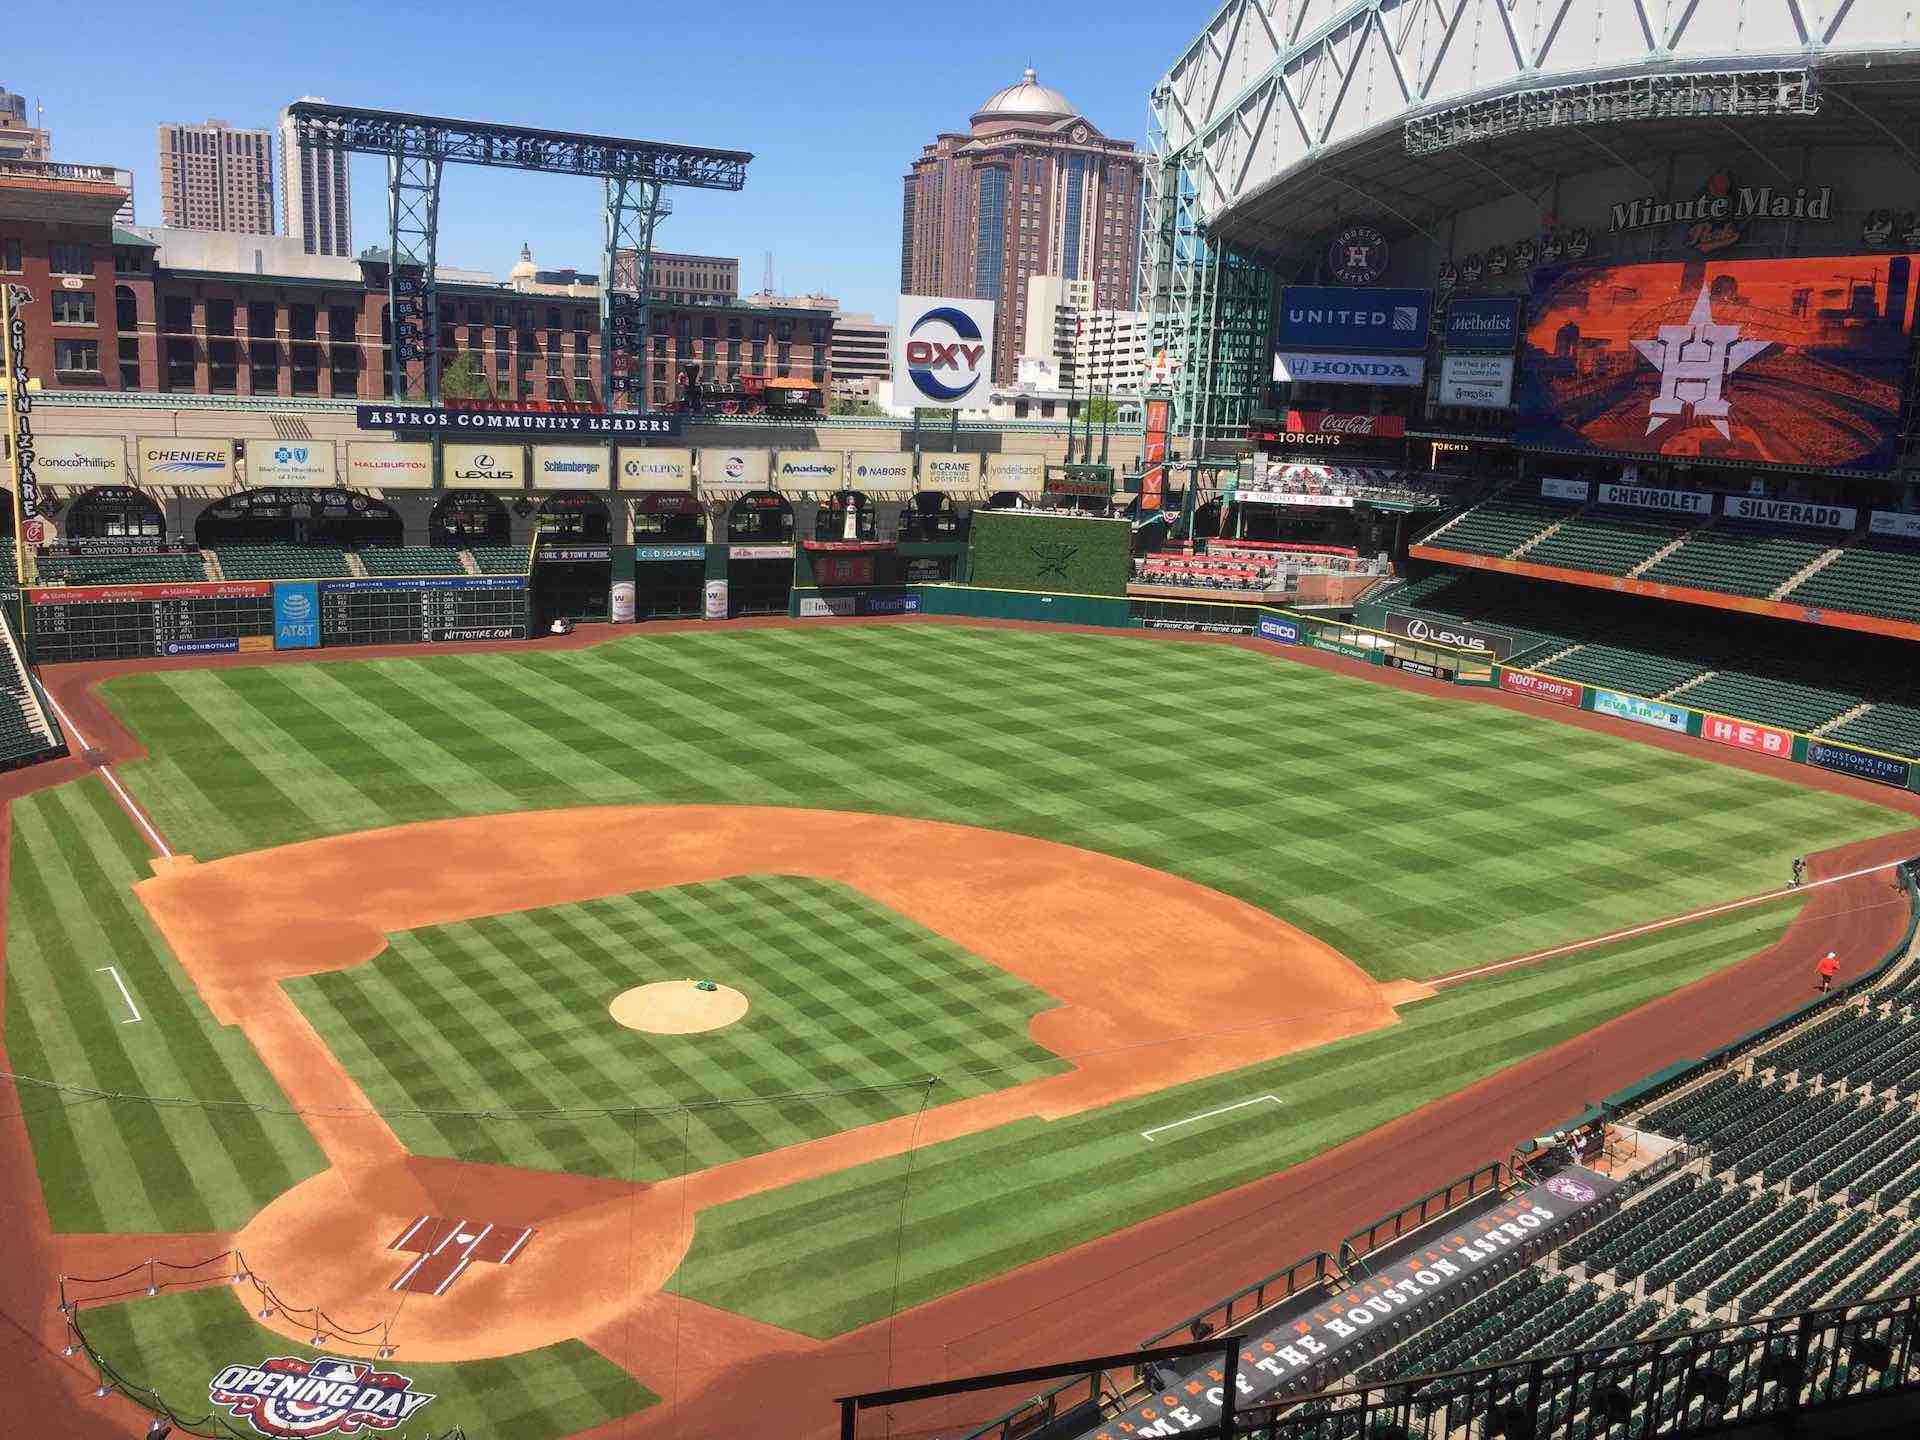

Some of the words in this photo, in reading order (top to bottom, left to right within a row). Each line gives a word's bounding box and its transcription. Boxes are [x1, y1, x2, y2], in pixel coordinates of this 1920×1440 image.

[1608, 194, 1729, 232] Minute
[1736, 185, 1832, 220] Maid
[1337, 229, 1383, 246] HOUSTON
[1289, 309, 1387, 326] UNITED
[1451, 314, 1511, 330] Methodist
[906, 341, 985, 371] OXY
[1311, 361, 1410, 377] HONDA
[370, 411, 448, 426] ASTROS
[457, 414, 580, 430] COMMUNITY
[589, 418, 671, 432] LEADERS
[1278, 431, 1341, 446] TORCHYS
[38, 456, 116, 470] ConocoPhillips
[148, 450, 225, 462] CHENIERE
[353, 461, 426, 469] HALLIBURTON
[544, 460, 601, 474] Schlumberger
[640, 463, 685, 473] CALPINE
[782, 462, 836, 475] Anadarko
[869, 466, 908, 477] NABORS
[938, 462, 970, 471] CRANE
[455, 470, 514, 479] LEXUS
[1607, 486, 1703, 512] CHEVROLET
[1738, 500, 1842, 526] SILVERADO
[80, 546, 128, 555] CRAWFORD
[130, 546, 159, 554] BOXES
[2, 592, 19, 601] 315
[282, 624, 314, 637] AT&T
[1261, 621, 1297, 640] GEICO
[1430, 628, 1486, 651] LEXUS
[1507, 672, 1538, 688] ROOT
[1536, 681, 1574, 697] SPORTS
[1603, 699, 1629, 714] EVA
[1816, 746, 1873, 767] HOUSTON'S
[1876, 759, 1904, 774] FIRST
[1121, 1406, 1202, 1440] ME
[1254, 1333, 1328, 1377] THE
[1324, 1256, 1462, 1338] HOUSTON
[1457, 1206, 1555, 1264] ASTROS
[214, 1366, 359, 1407] OPENING
[352, 1388, 428, 1417] DAY
